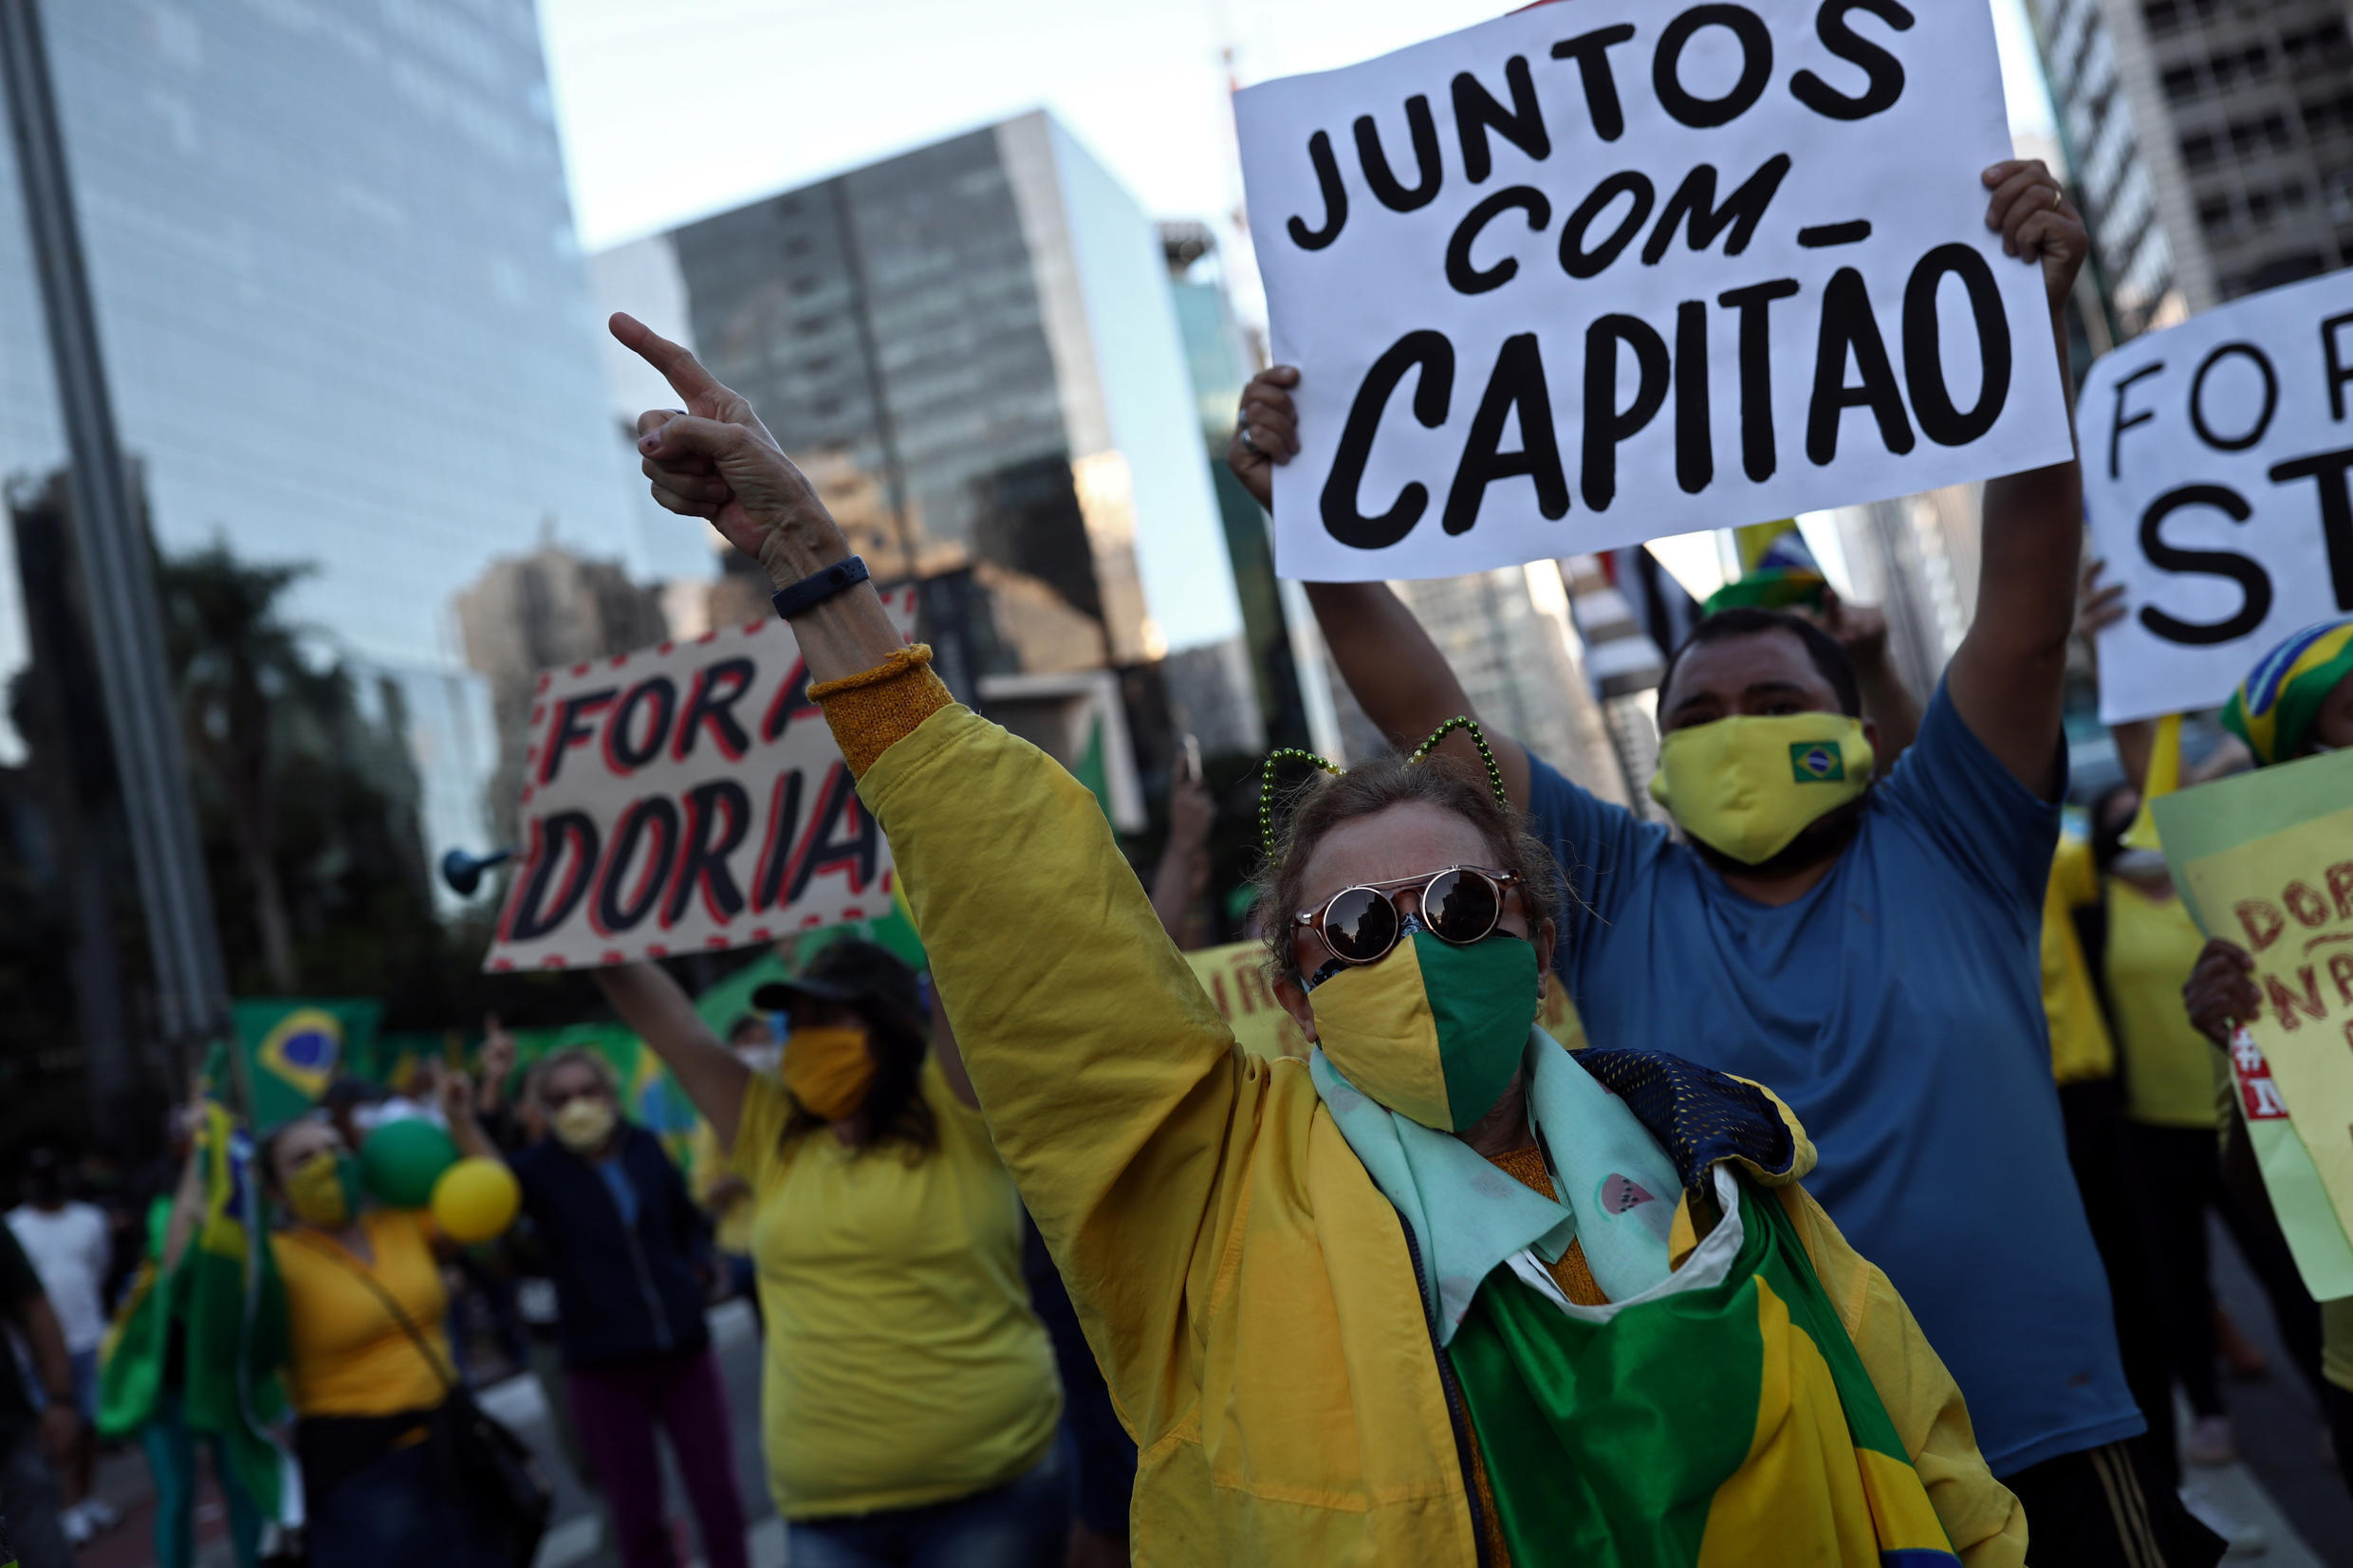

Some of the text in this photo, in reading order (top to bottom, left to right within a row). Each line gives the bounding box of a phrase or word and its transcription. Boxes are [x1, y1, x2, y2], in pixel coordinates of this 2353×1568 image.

[1288, 0, 1915, 250] JUNTOS
[1445, 153, 1792, 295] COM
[1320, 219, 2011, 550] CAPITÃO
[496, 760, 879, 944] DORIA
